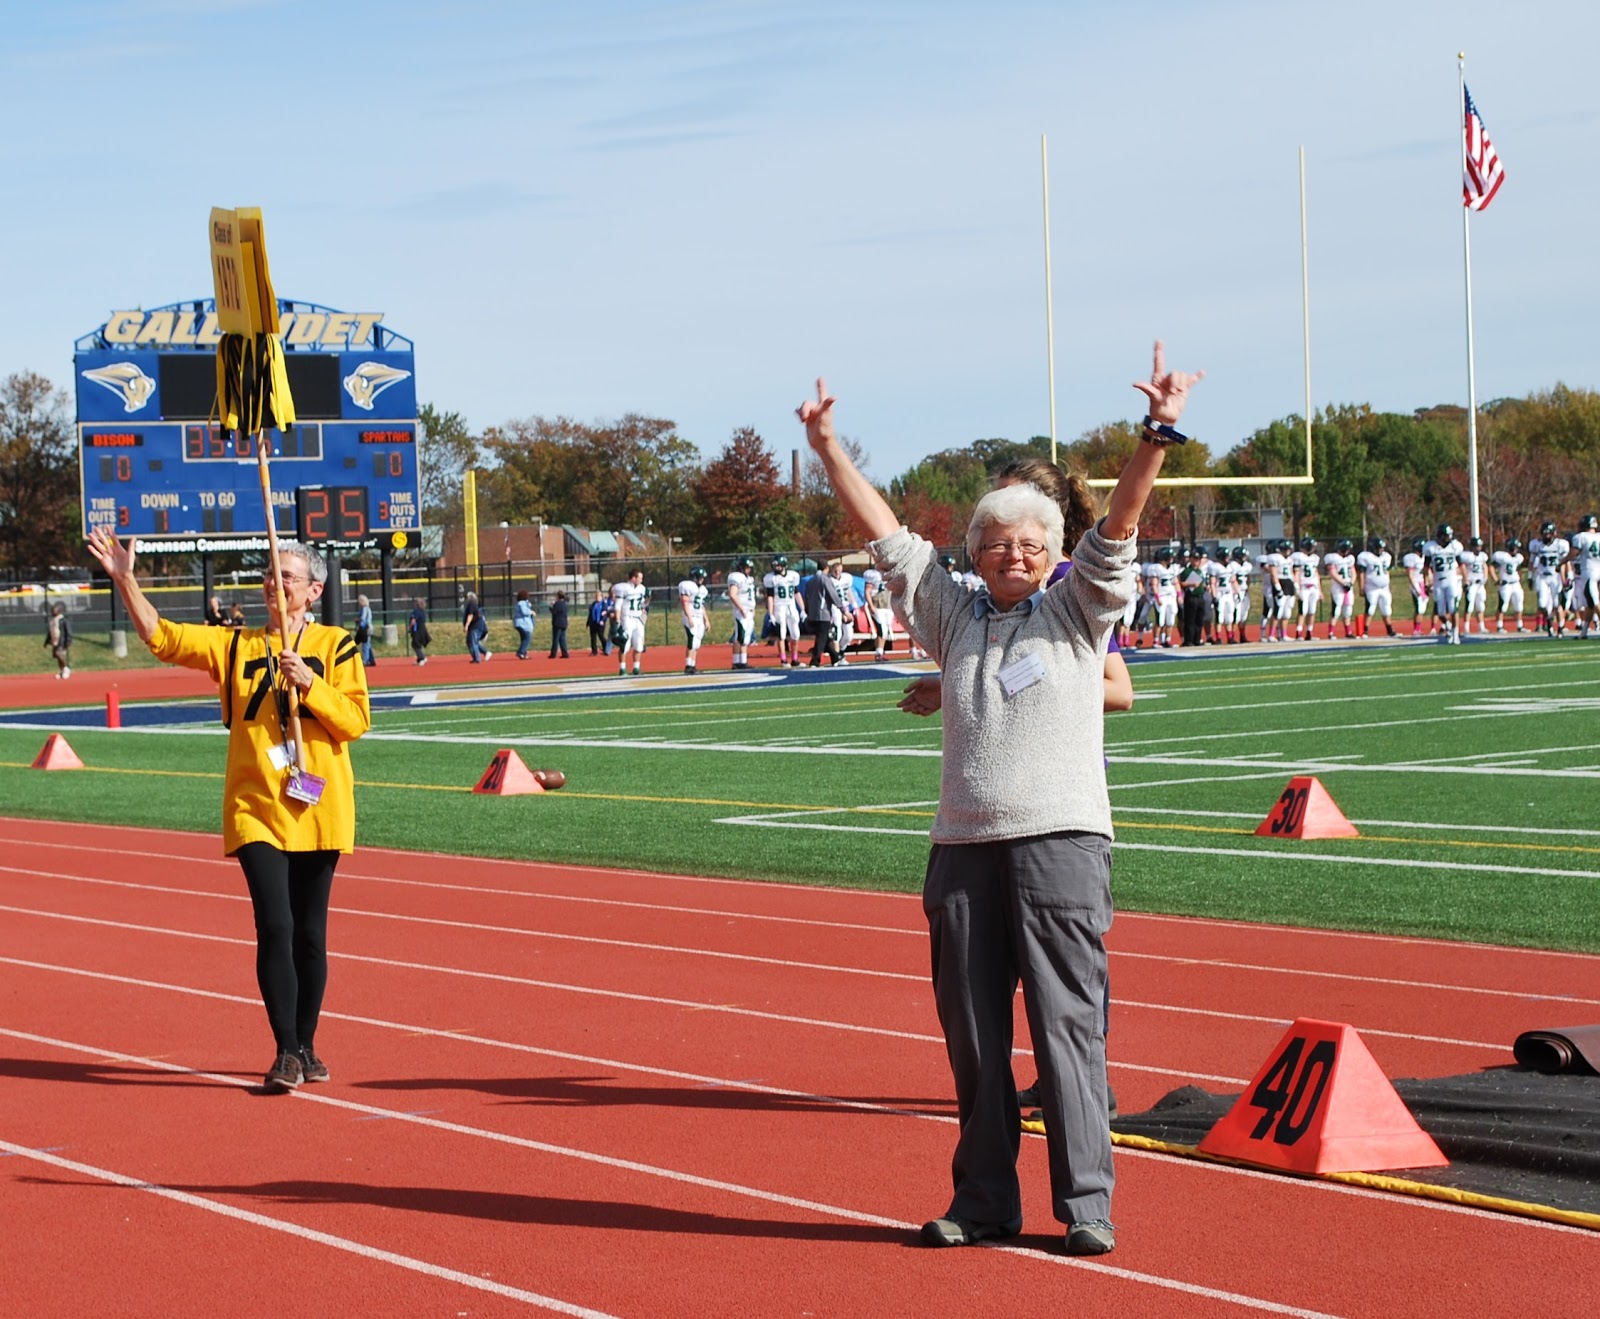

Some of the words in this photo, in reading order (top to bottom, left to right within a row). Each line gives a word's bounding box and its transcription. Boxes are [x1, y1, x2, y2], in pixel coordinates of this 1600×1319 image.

[104, 311, 384, 344] GALLDET
[93, 434, 136, 447] BISON
[362, 431, 411, 443] SPARTANS
[91, 498, 115, 510] TIME
[141, 494, 180, 508] DOWN
[199, 493, 215, 506] TO
[218, 492, 236, 506] GO
[390, 492, 412, 503] TIME
[306, 490, 364, 538] 25
[390, 504, 416, 516] OUTS
[88, 511, 117, 523] OUTS
[390, 517, 413, 528] LEFT
[135, 540, 196, 553] Sorenson
[1271, 787, 1308, 834] 30
[1249, 1037, 1337, 1146] 40
